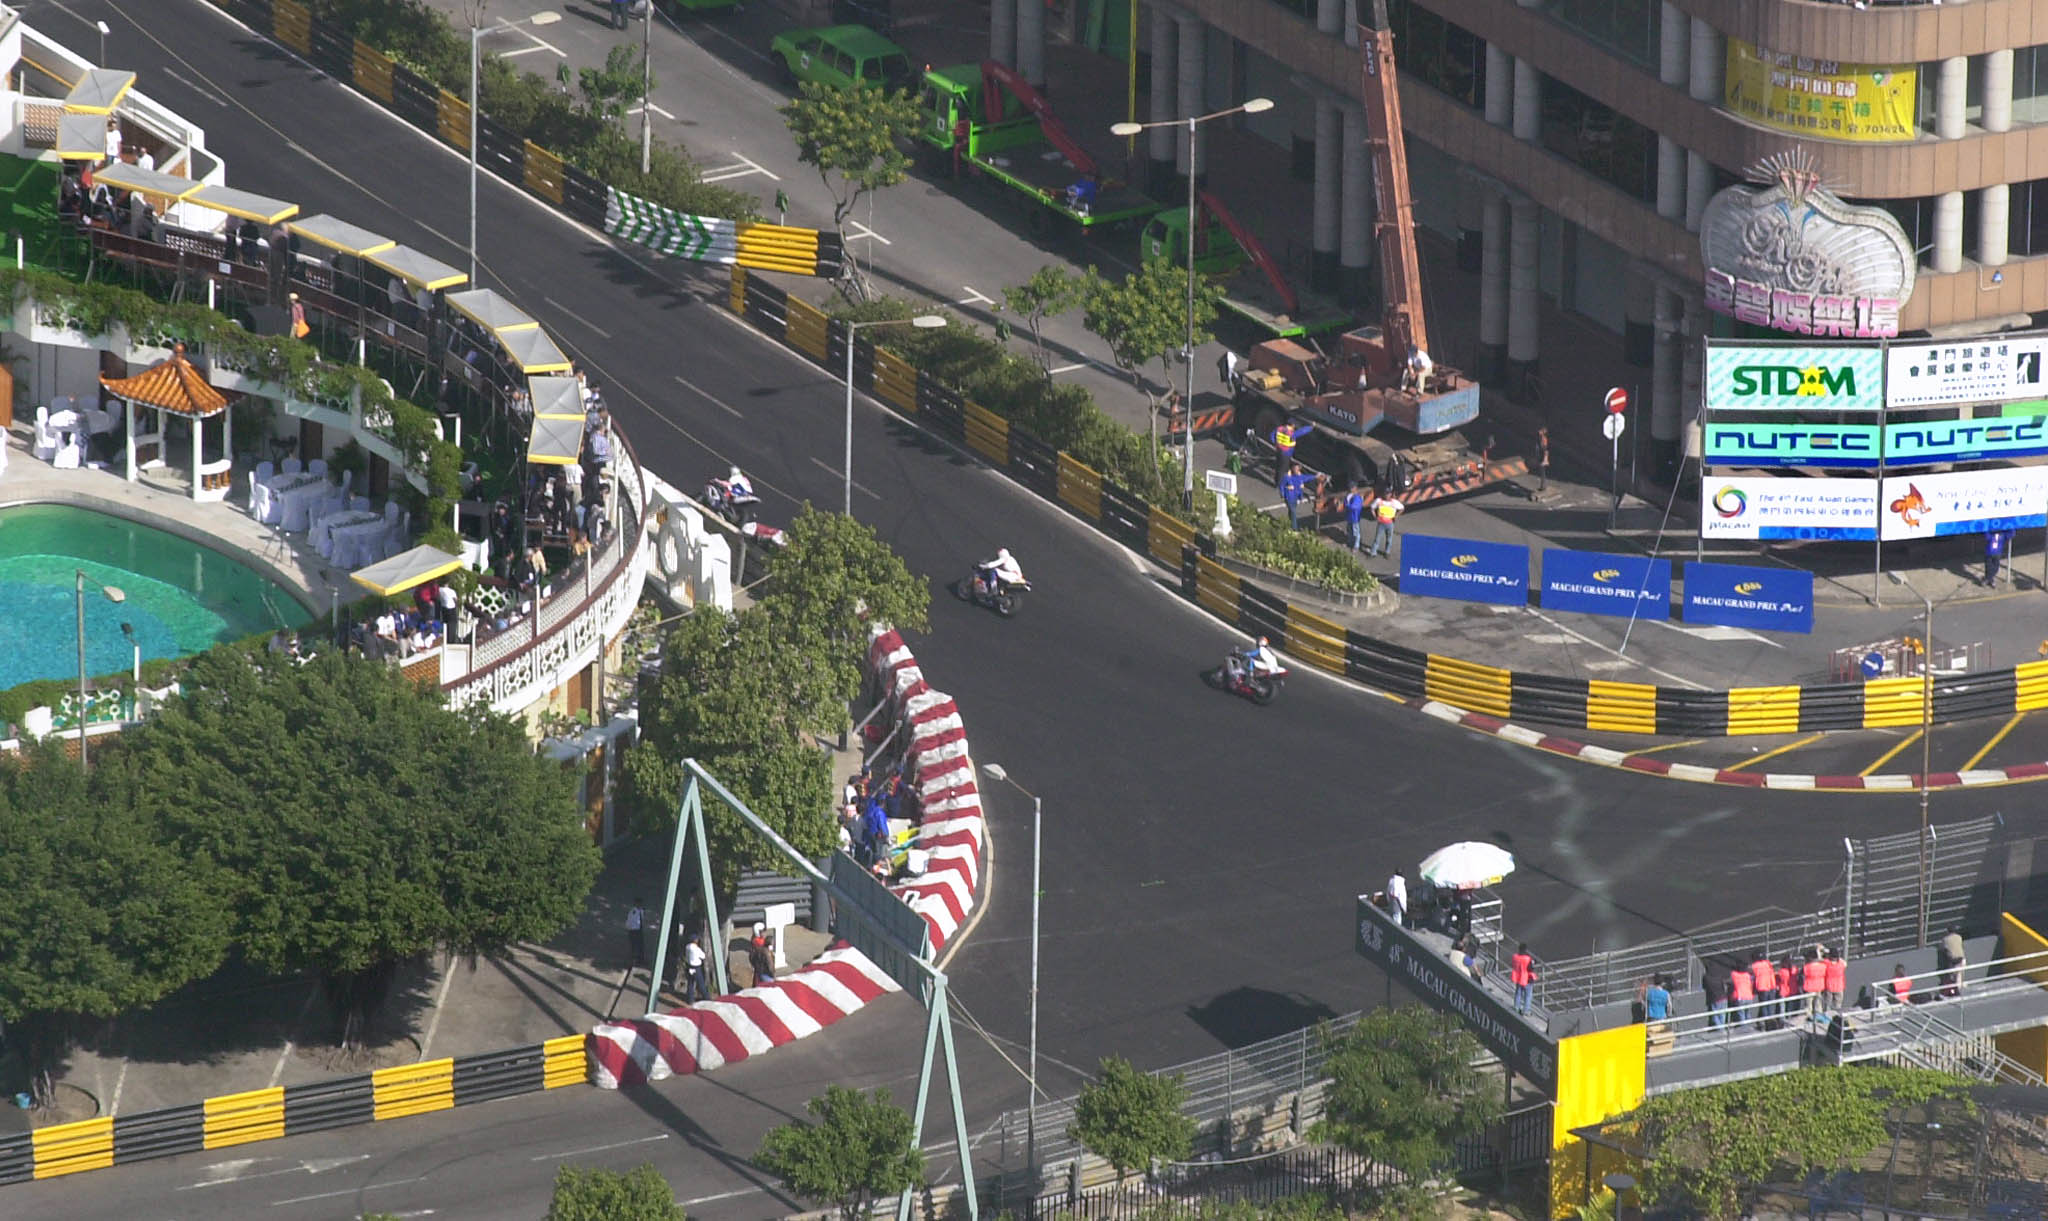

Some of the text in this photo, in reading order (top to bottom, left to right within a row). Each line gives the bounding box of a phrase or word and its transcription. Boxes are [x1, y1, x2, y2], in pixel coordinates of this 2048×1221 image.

[1329, 405, 1357, 423] KATO
[1409, 566, 1440, 578] MACAU
[1441, 570, 1473, 582] GRAND
[1473, 573, 1495, 584] PRIX
[1550, 581, 1582, 593] MACAU
[1582, 584, 1614, 596] GRAND
[1615, 588, 1636, 599] PRIX
[1692, 595, 1724, 607] MACAU
[1724, 598, 1756, 609] GRAND
[1757, 601, 1778, 611] PRIX
[1406, 955, 1448, 999] MACAU
[1449, 988, 1491, 1030] GRAND
[1491, 1019, 1521, 1054] PRIX
